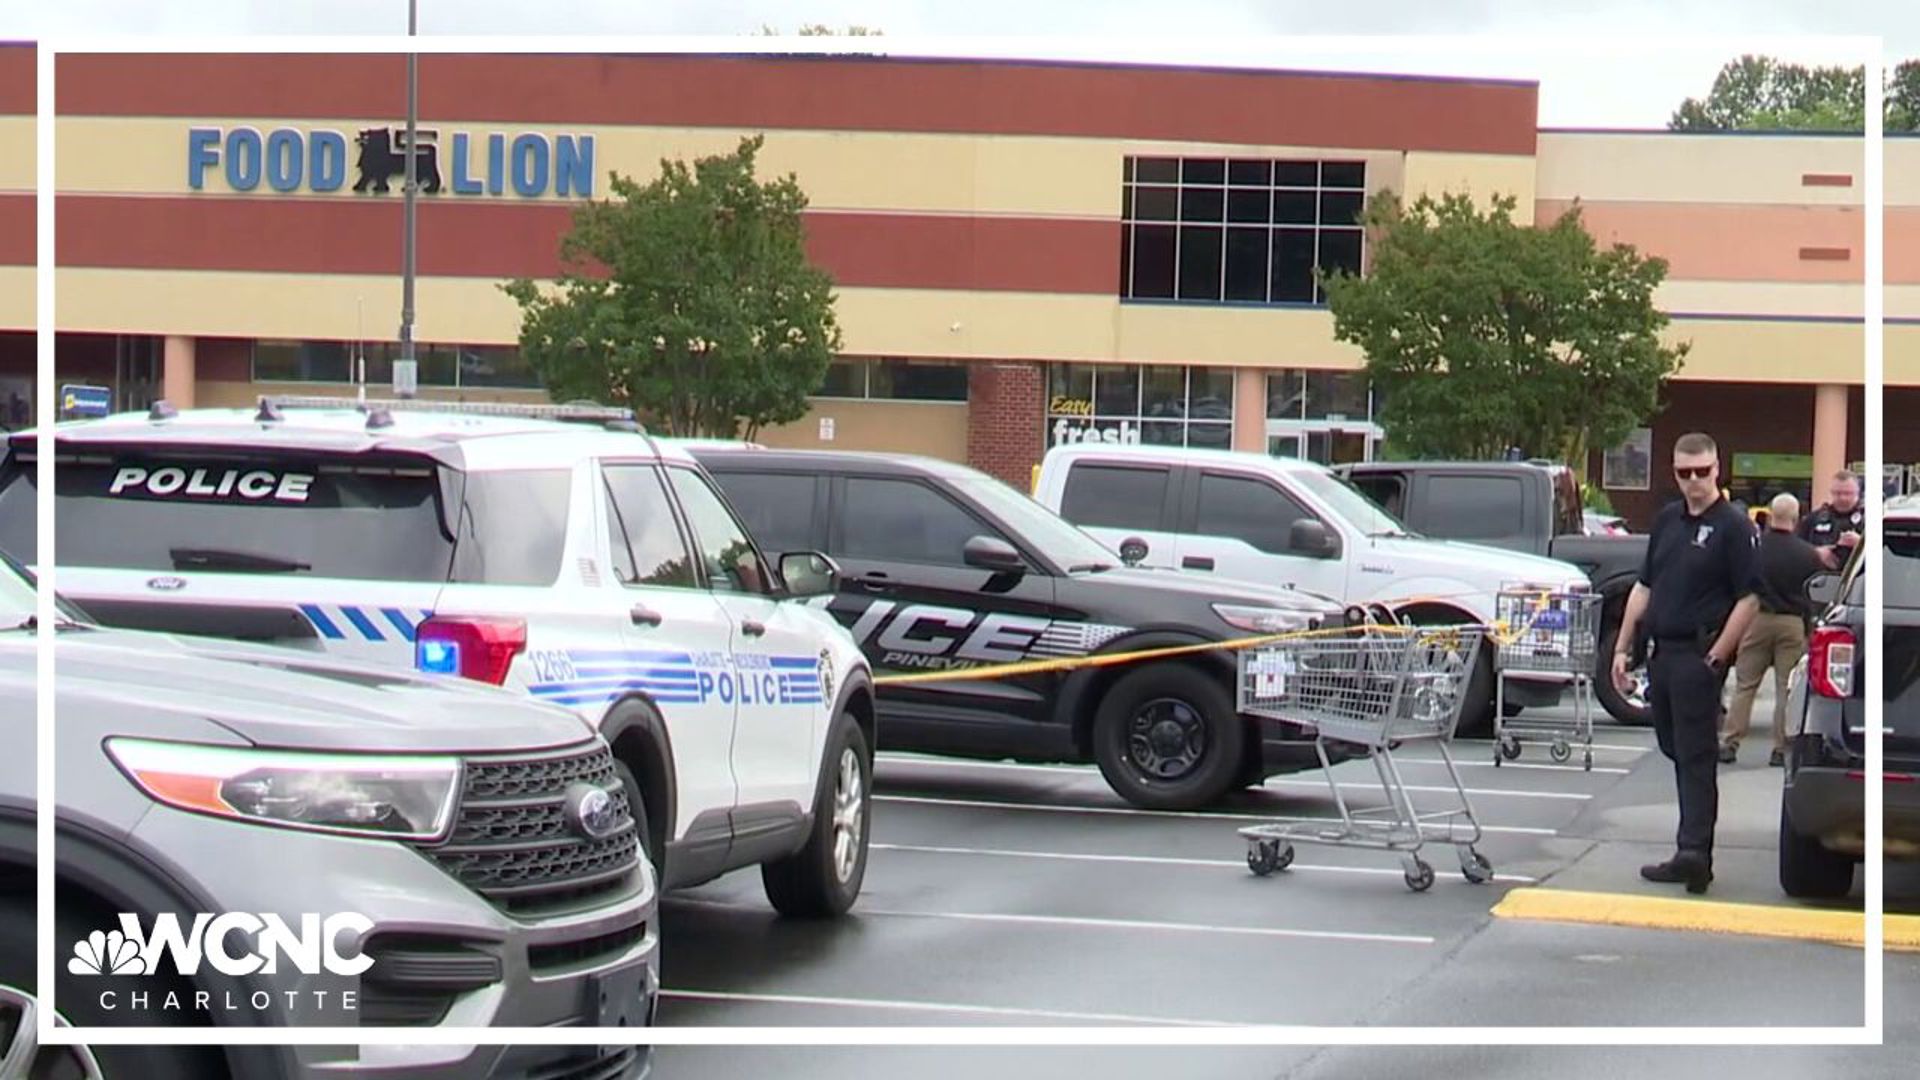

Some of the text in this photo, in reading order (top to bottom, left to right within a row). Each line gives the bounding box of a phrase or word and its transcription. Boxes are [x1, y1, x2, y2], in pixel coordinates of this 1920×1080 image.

[188, 127, 595, 196] FOOD LION
[1050, 396, 1091, 424] Easy
[1053, 419, 1140, 446] fresh
[109, 467, 314, 500] POLICE
[528, 649, 575, 682] 1266
[698, 671, 790, 704] POLICE
